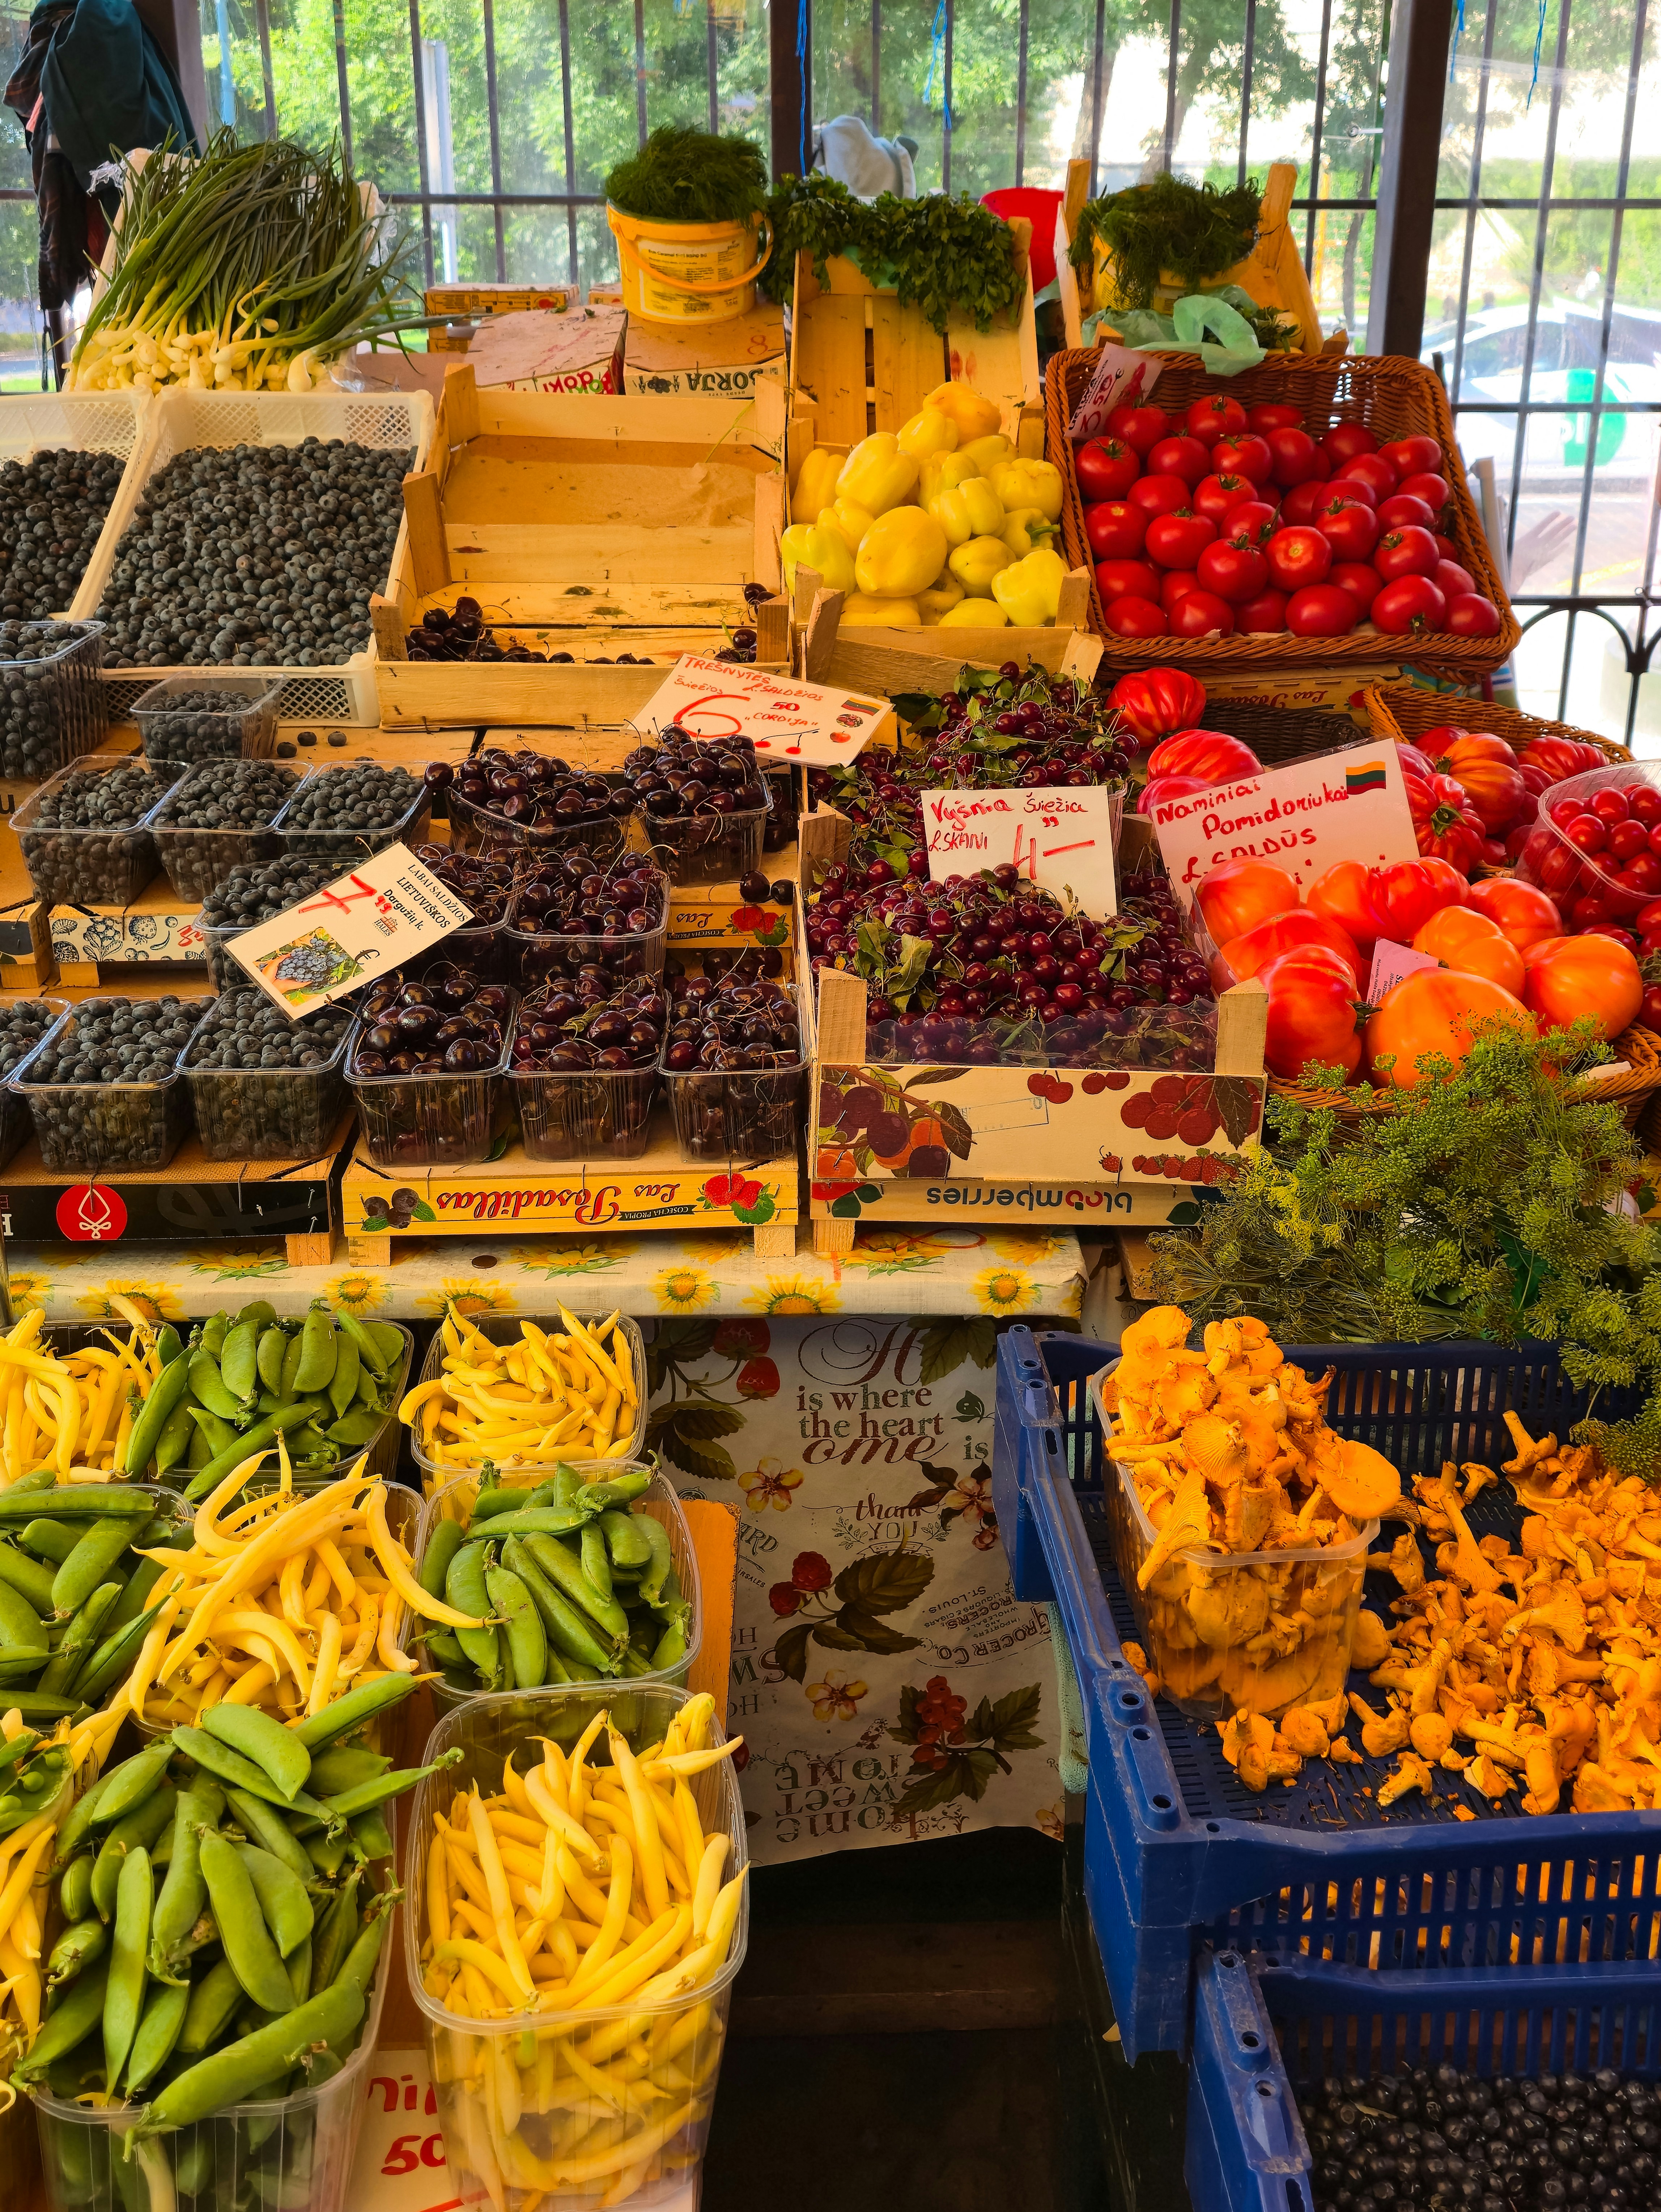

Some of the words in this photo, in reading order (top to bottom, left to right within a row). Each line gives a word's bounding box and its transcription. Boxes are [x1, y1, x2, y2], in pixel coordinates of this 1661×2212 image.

[673, 694, 751, 738] 6
[770, 702, 800, 711] 50
[1156, 779, 1261, 826] Naminiai
[1202, 782, 1350, 840] Pomidoriukai
[298, 873, 378, 915] 7
[396, 877, 450, 928] LIETUVIŠKOS
[408, 863, 433, 888] LABAI
[429, 885, 468, 923] SALDŽIOS
[374, 919, 392, 937] HALES
[676, 912, 713, 928] Las
[436, 1185, 622, 1226] Posadillas
[634, 1183, 681, 1203] Las
[926, 1185, 1133, 1214] bloomberries
[624, 1211, 652, 1220] PROPIA
[653, 1206, 689, 1216] COSECHA
[796, 1385, 823, 1411] is
[830, 1383, 933, 1411] where
[798, 1411, 851, 1439] the
[858, 1411, 944, 1439] heart
[963, 1435, 989, 1461] is
[867, 1520, 919, 1542] YOU
[963, 1592, 1001, 1613] LIQUORS
[923, 1613, 955, 1628] CIGARS
[965, 1606, 1019, 1631] WHOLESALE
[973, 1617, 1020, 1638] IMPORTERS
[985, 1619, 1001, 1628] AND
